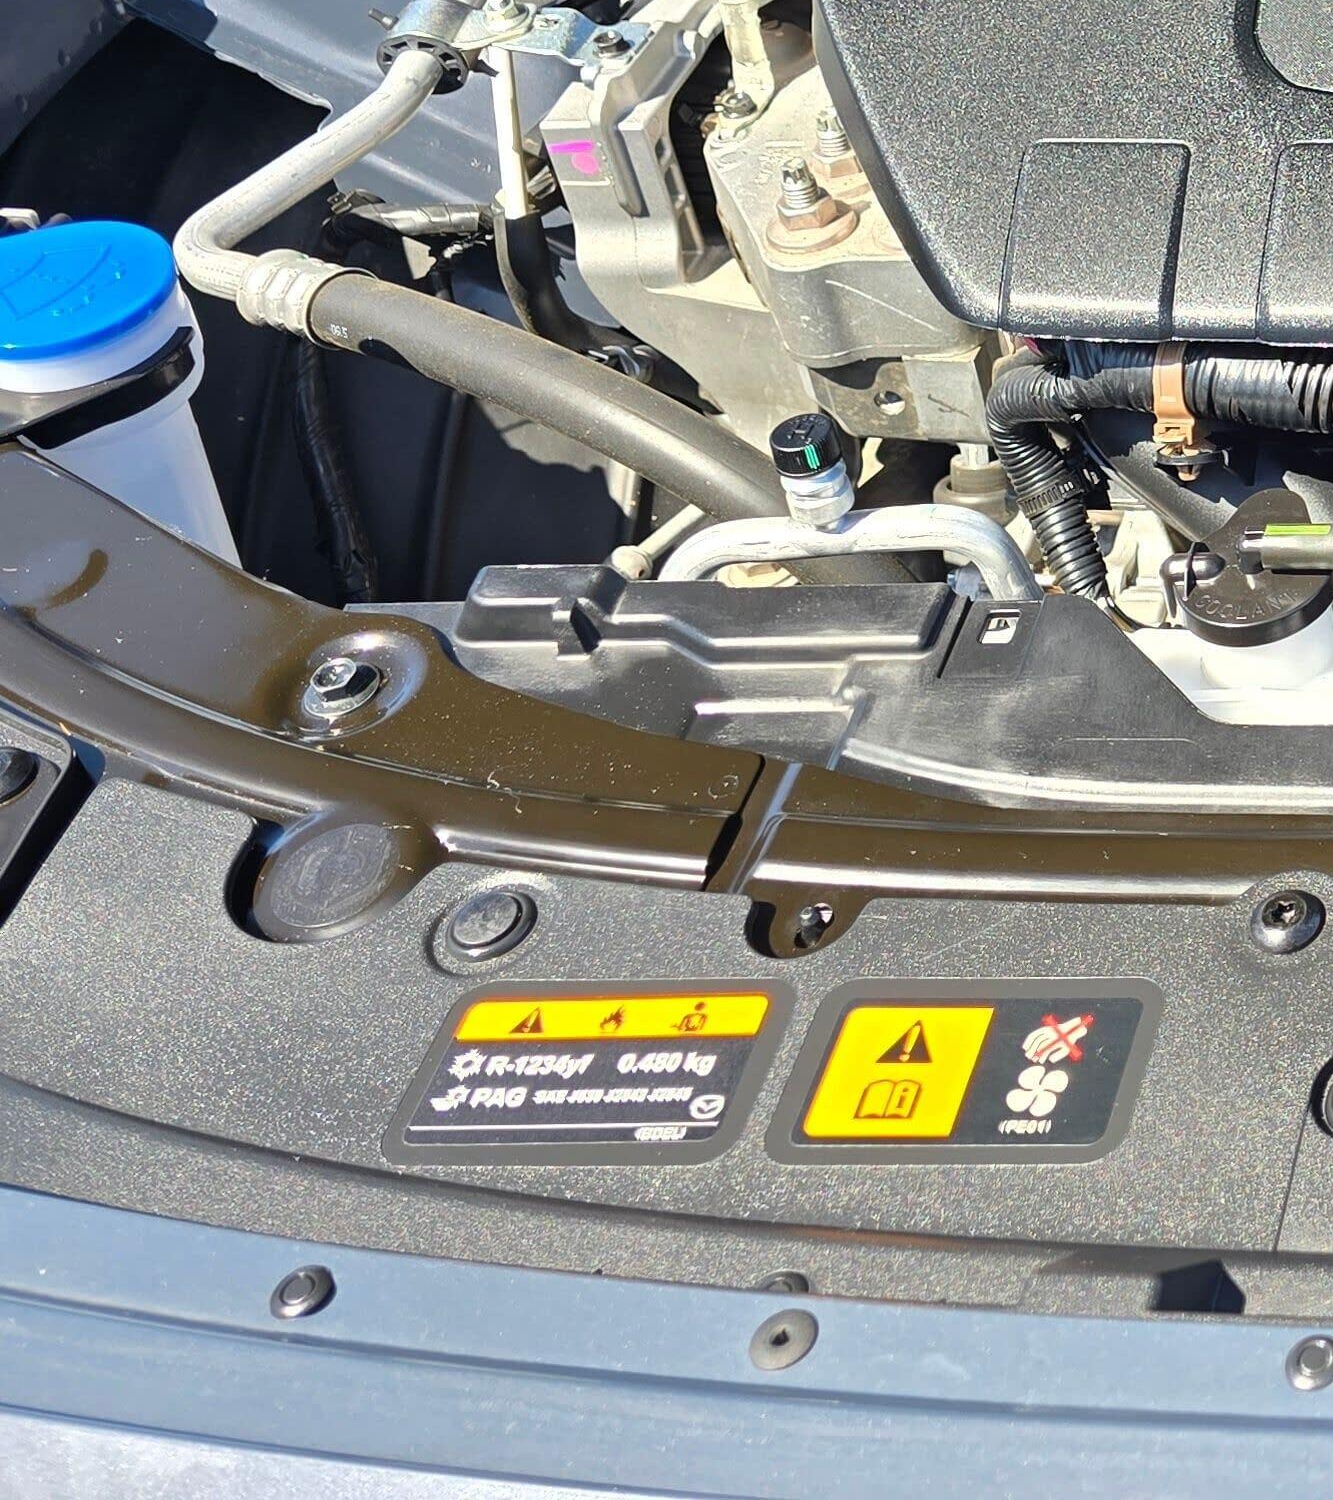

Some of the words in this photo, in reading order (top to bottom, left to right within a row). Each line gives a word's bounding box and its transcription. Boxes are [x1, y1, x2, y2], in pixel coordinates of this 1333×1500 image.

[1195, 591, 1298, 620] COOLANT
[616, 1052, 680, 1074] 0.480
[683, 1052, 718, 1076] kg
[470, 1087, 528, 1109] PAG
